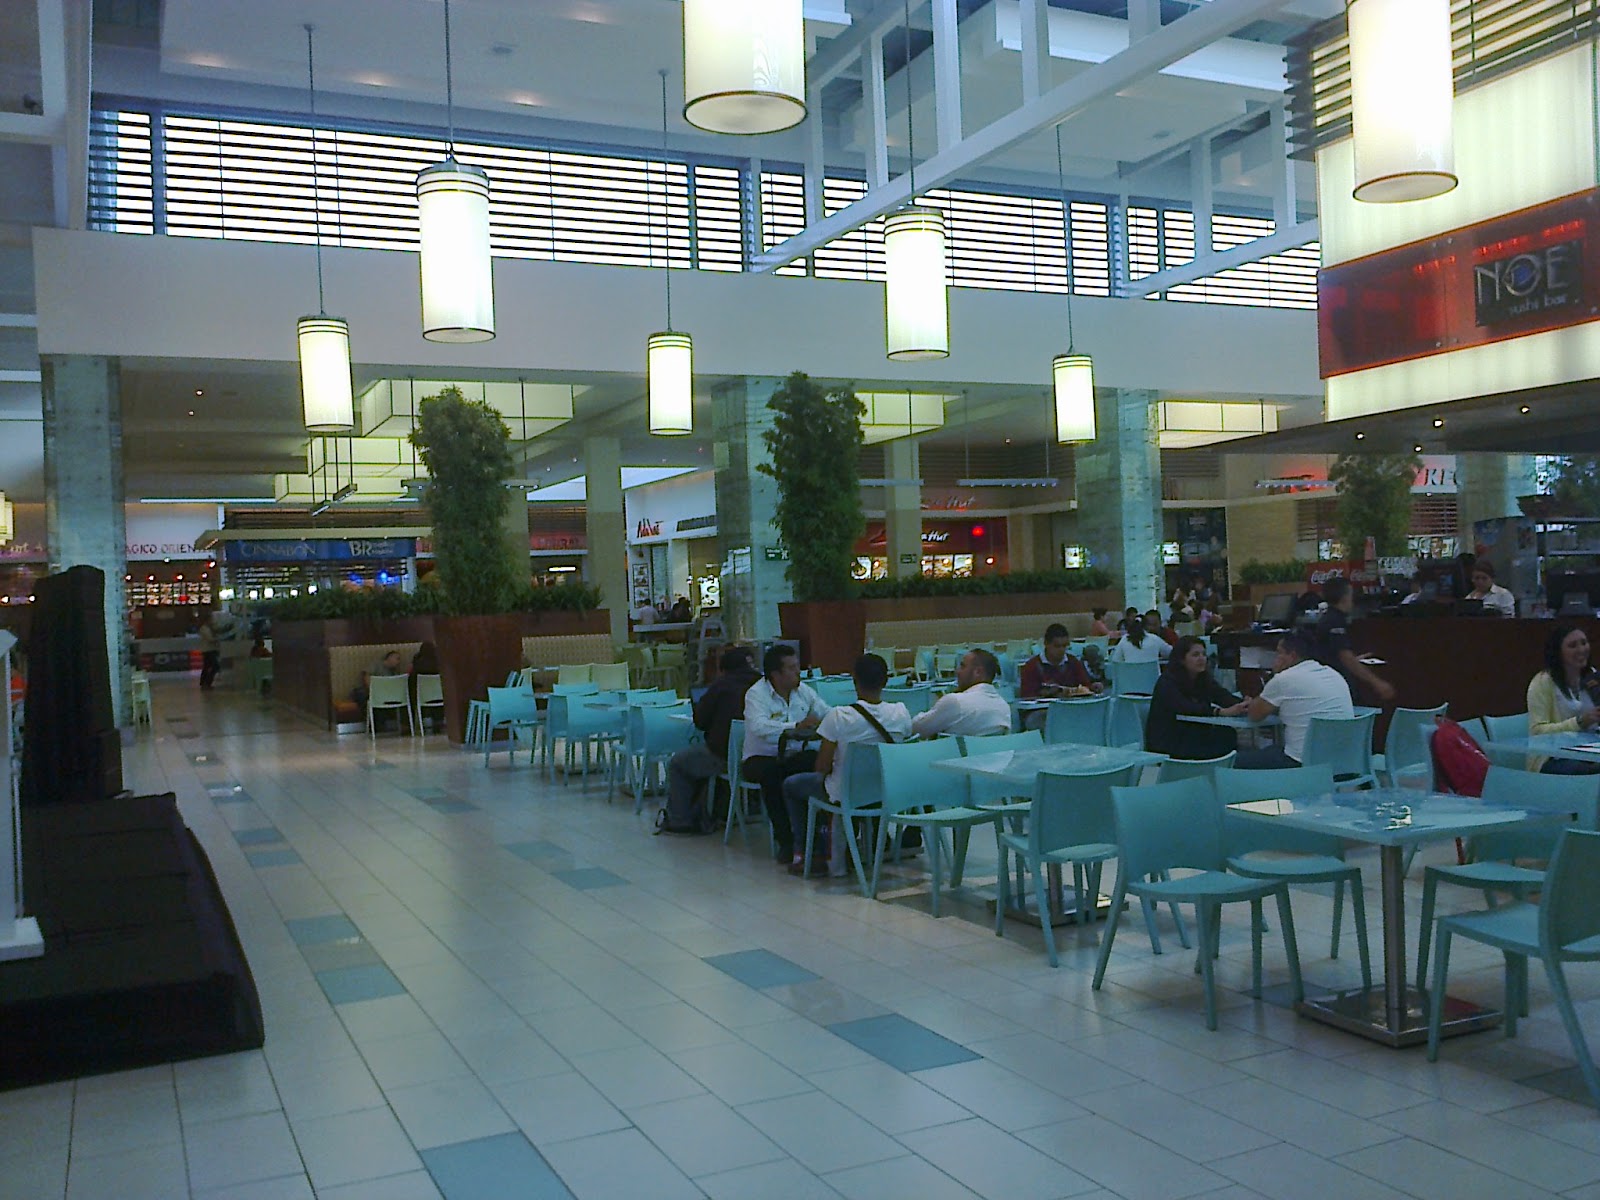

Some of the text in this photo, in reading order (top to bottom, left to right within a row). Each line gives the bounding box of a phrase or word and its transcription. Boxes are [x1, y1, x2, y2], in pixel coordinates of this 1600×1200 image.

[1474, 246, 1569, 304] NOE
[1544, 294, 1567, 306] bar
[927, 530, 949, 542] Hut
[126, 544, 157, 554] AGICO
